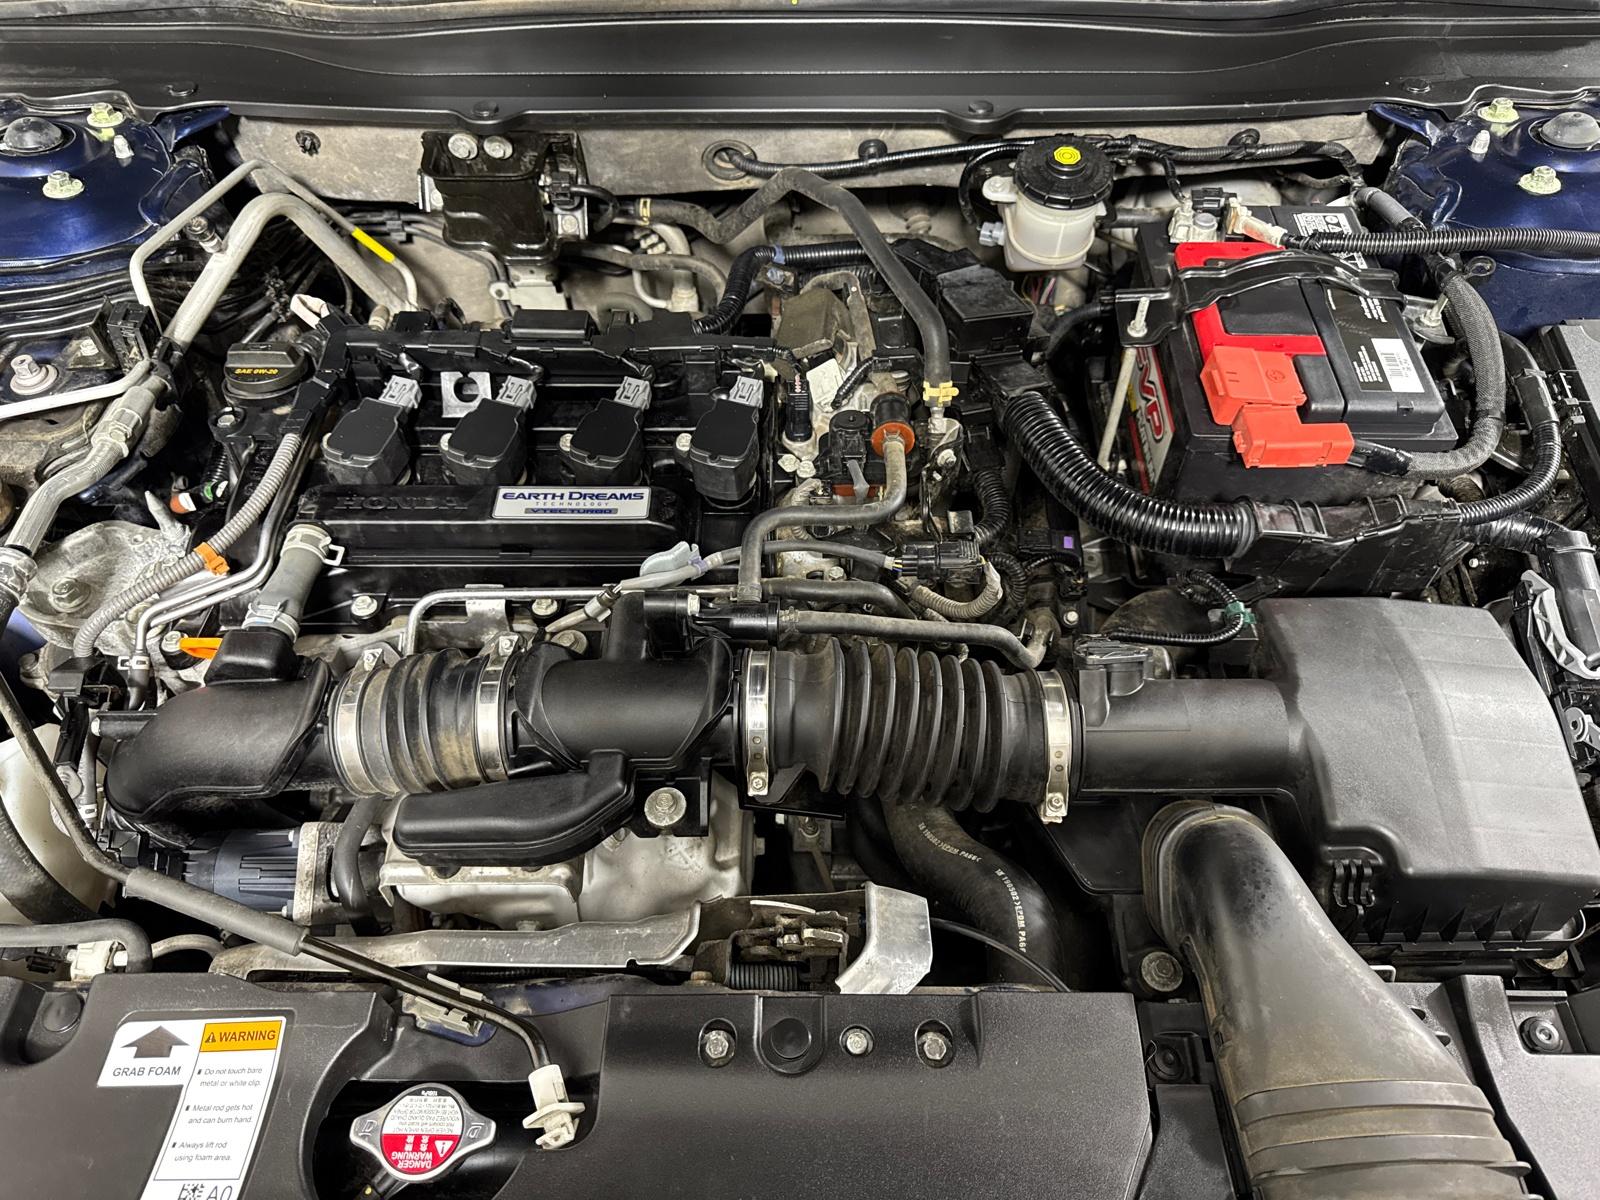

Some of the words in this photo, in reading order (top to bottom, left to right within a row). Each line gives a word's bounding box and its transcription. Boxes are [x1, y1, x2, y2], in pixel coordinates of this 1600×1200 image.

[502, 492, 564, 500] EARTH
[568, 491, 645, 500] DREAMS
[334, 497, 468, 509] HONDA
[219, 1030, 276, 1042] WARNING
[112, 1066, 145, 1077] GRAB
[148, 1066, 182, 1076] FOAM
[227, 1067, 246, 1075] touch
[229, 1079, 248, 1087] white
[225, 1104, 240, 1112] gets
[178, 1142, 204, 1150] Always
[214, 1141, 228, 1149] rod
[391, 1152, 432, 1160] WARNUNG
[398, 1160, 432, 1168] DANGER
